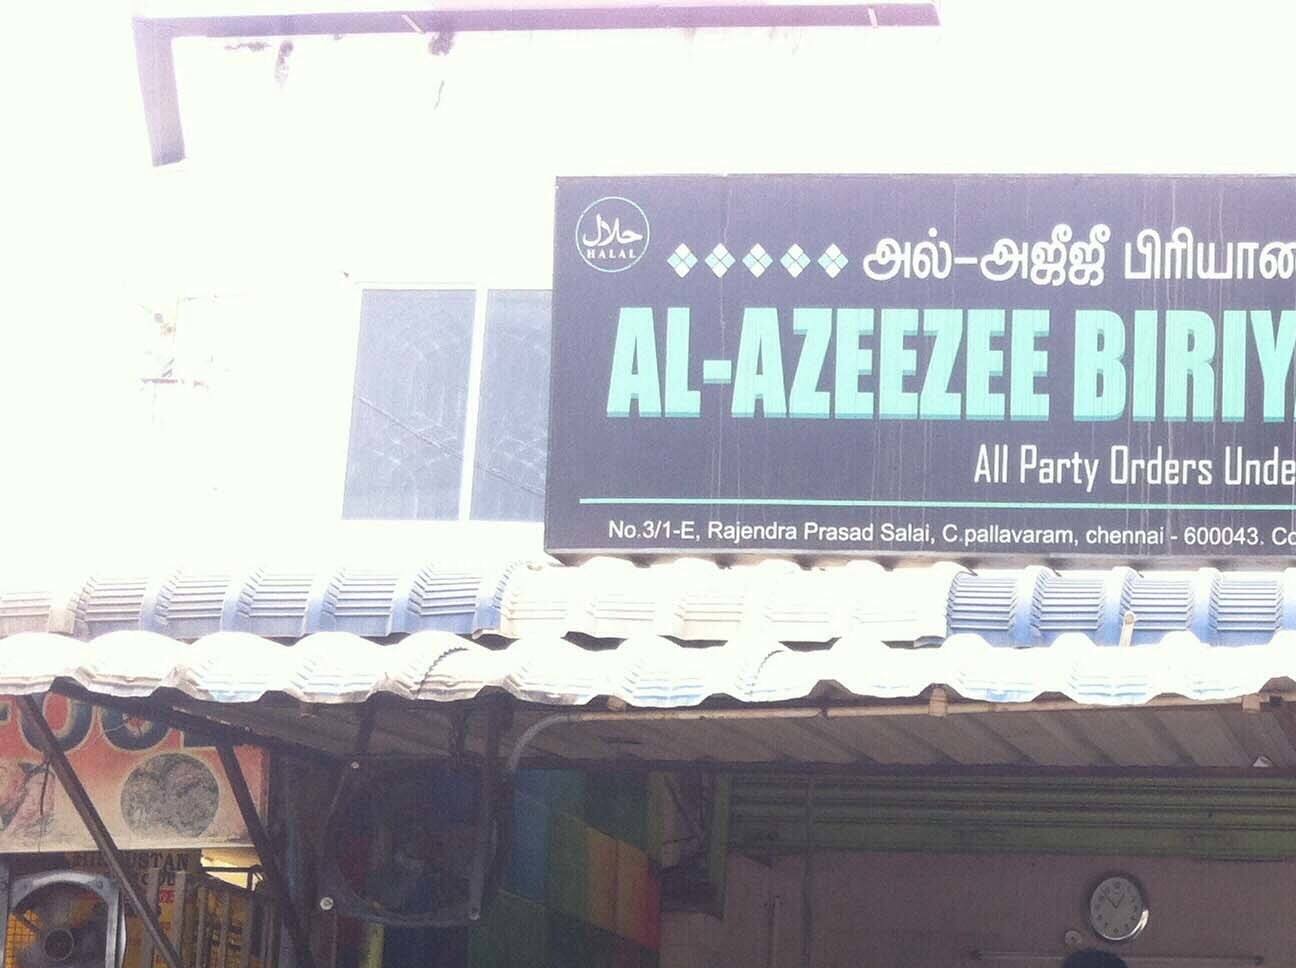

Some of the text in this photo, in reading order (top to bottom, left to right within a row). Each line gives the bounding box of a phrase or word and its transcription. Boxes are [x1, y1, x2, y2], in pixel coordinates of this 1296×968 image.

[582, 213, 643, 247] حلال
[587, 249, 636, 259] HALAL
[863, 224, 1112, 287] அல்-அஜீஜீ
[606, 307, 1050, 422] AL-AZEEZEE
[974, 446, 1009, 485] All
[1020, 446, 1100, 492] Party
[1111, 447, 1213, 487] Orders
[608, 519, 702, 543] No.3/1-E,
[708, 520, 797, 544] Rajendra
[804, 522, 875, 543] Prasad
[880, 523, 936, 547] Salai,
[942, 523, 1078, 549] C.pallavaram,
[1086, 525, 1165, 546] chennai
[1184, 526, 1265, 547] 600043.
